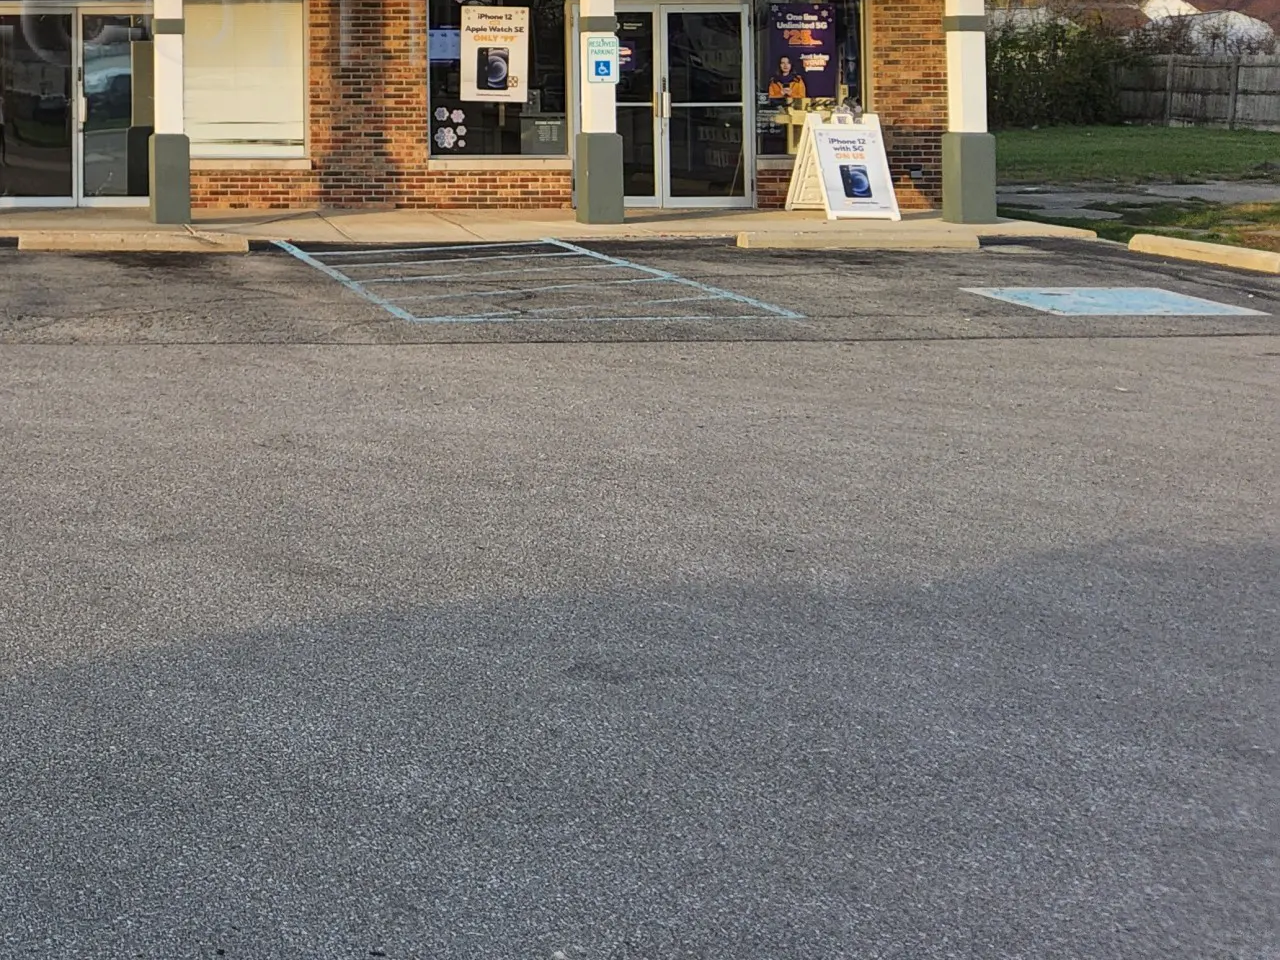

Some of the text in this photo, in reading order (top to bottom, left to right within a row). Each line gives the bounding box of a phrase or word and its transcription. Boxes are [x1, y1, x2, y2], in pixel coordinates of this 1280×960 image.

[477, 13, 513, 21] iPhone 12
[786, 13, 802, 21] One
[465, 25, 488, 33] Apple
[489, 25, 513, 33] Watch
[776, 21, 816, 29] Unlimited
[473, 34, 498, 42] ONLY
[588, 40, 616, 48] RESERVED
[590, 48, 615, 56] PARKING
[828, 137, 856, 145] iPhone
